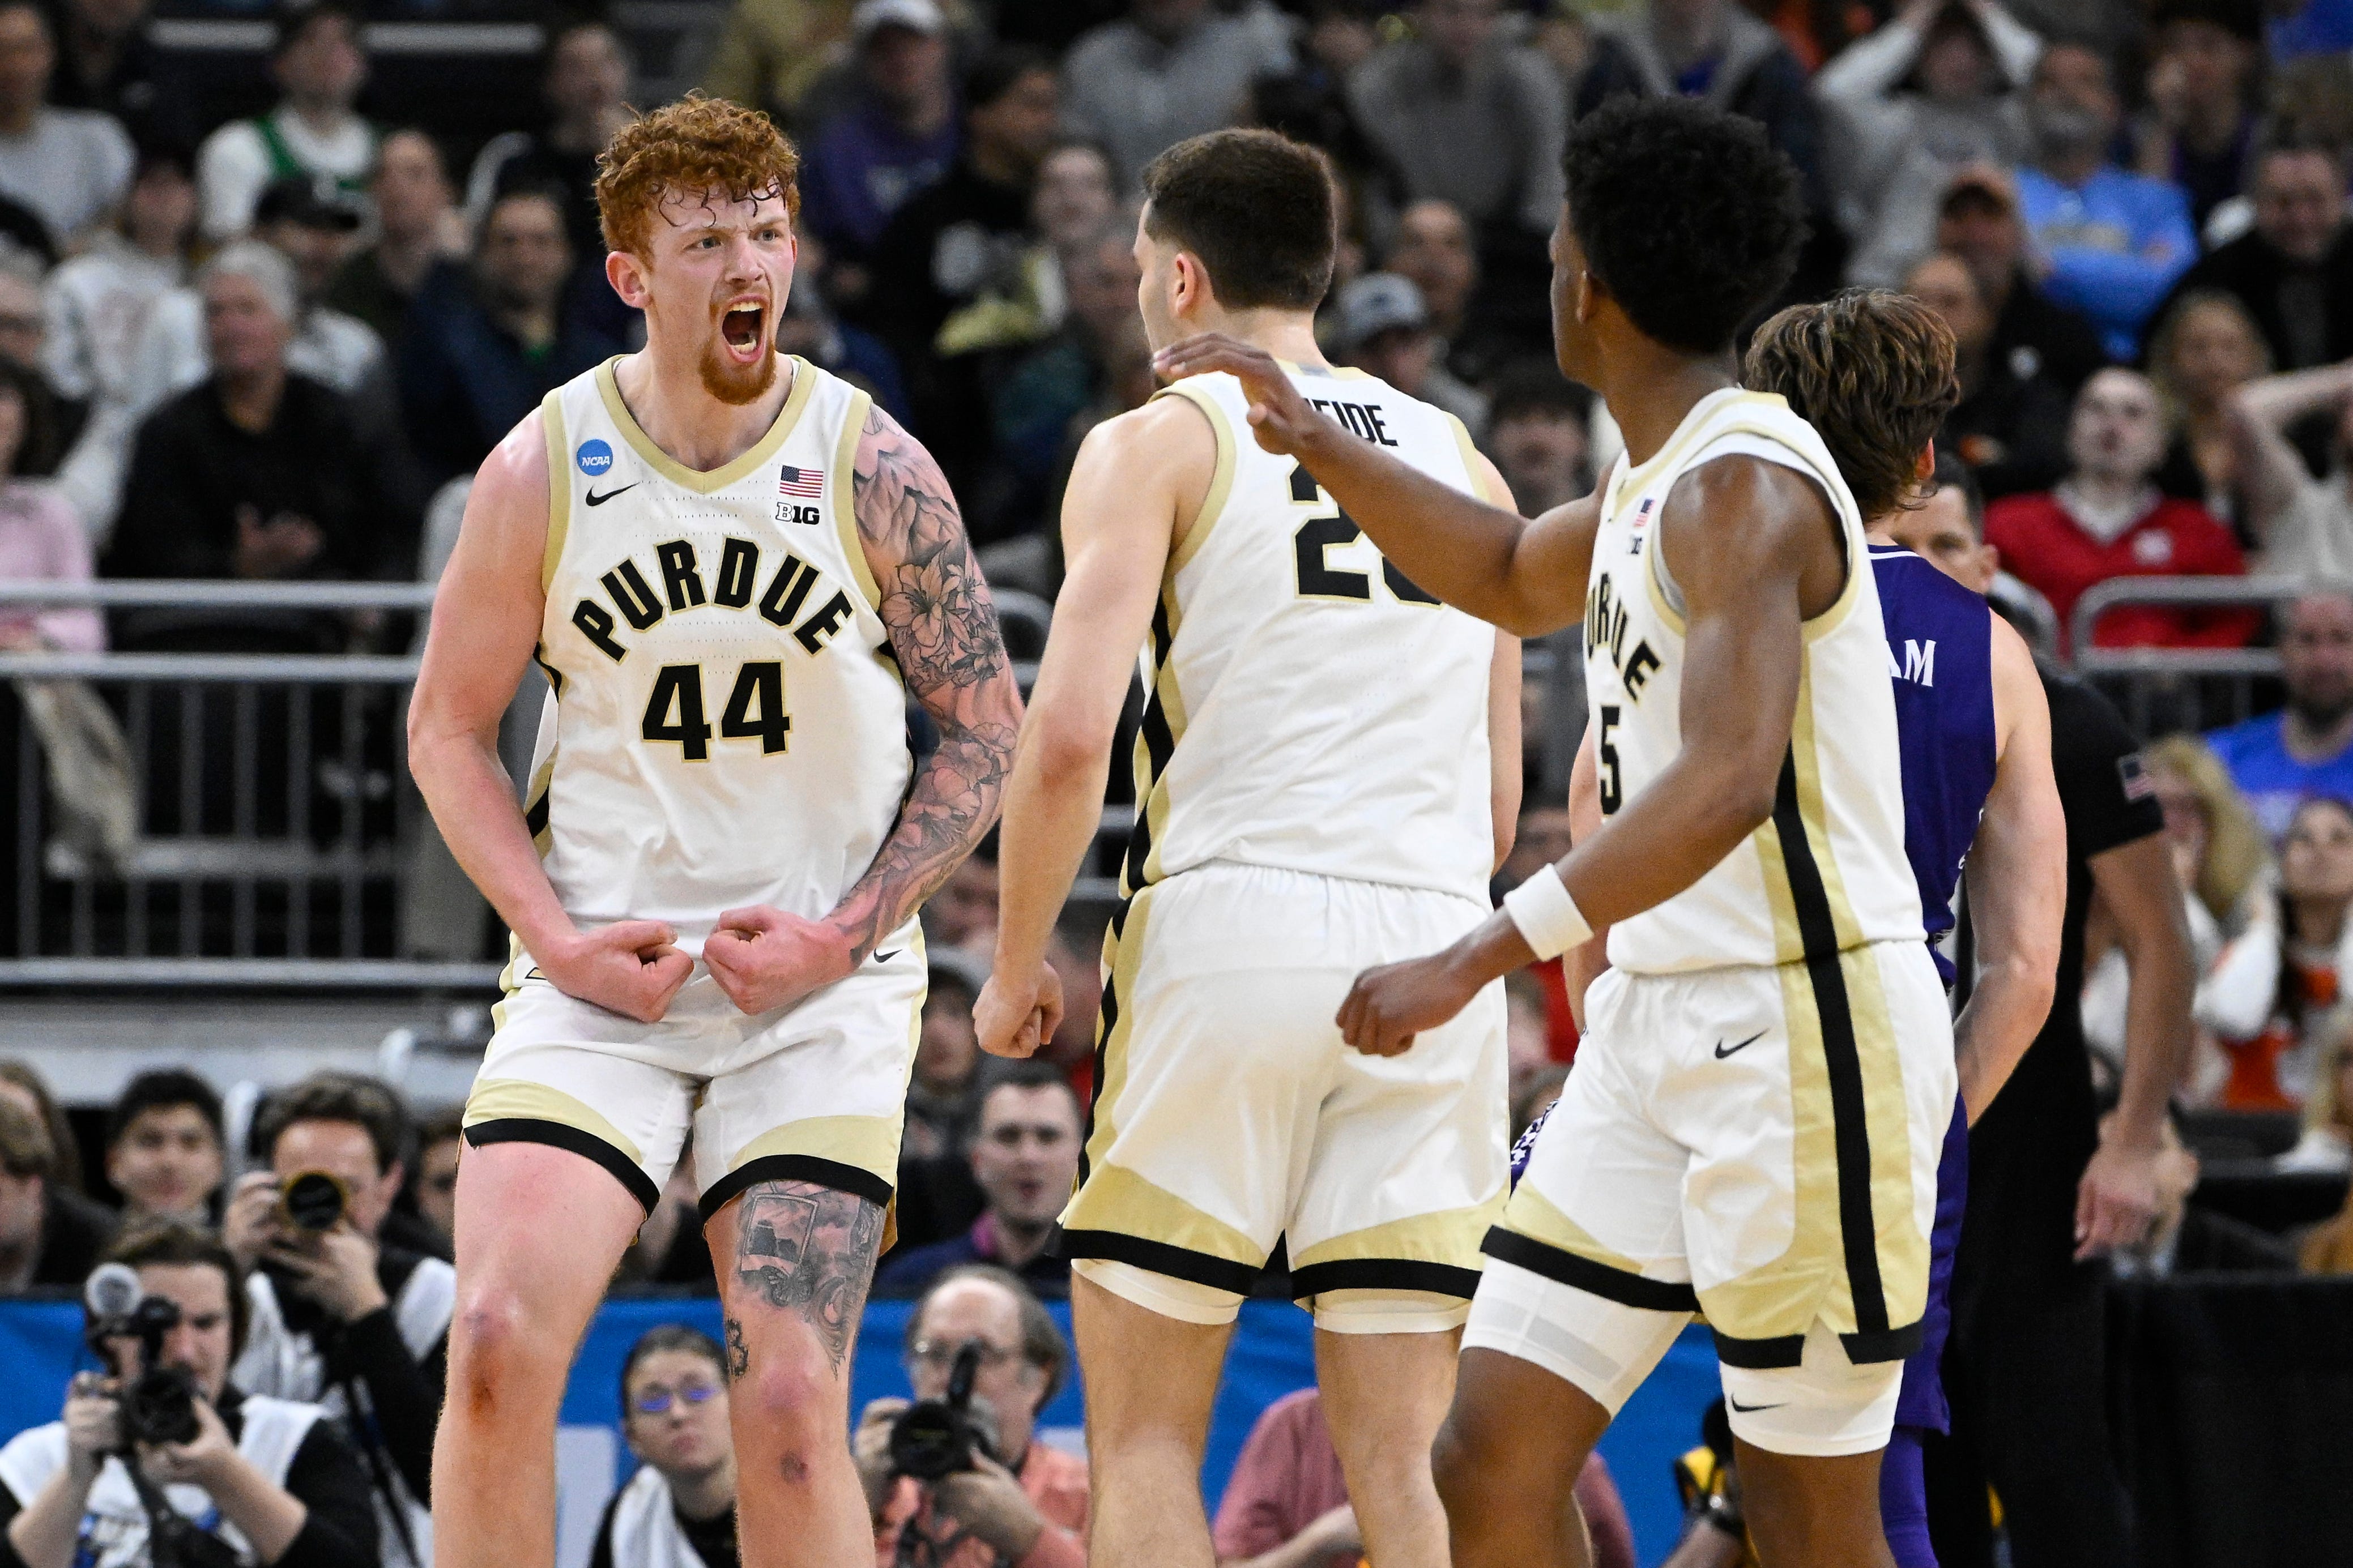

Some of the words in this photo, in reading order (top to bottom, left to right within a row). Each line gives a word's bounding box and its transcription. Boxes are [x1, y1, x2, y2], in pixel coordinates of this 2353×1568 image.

[582, 455, 610, 467] NCAA
[1286, 462, 1444, 610] 2
[571, 537, 854, 664] PURDUE
[640, 660, 793, 763] 44
[1600, 704, 1622, 816] 5
